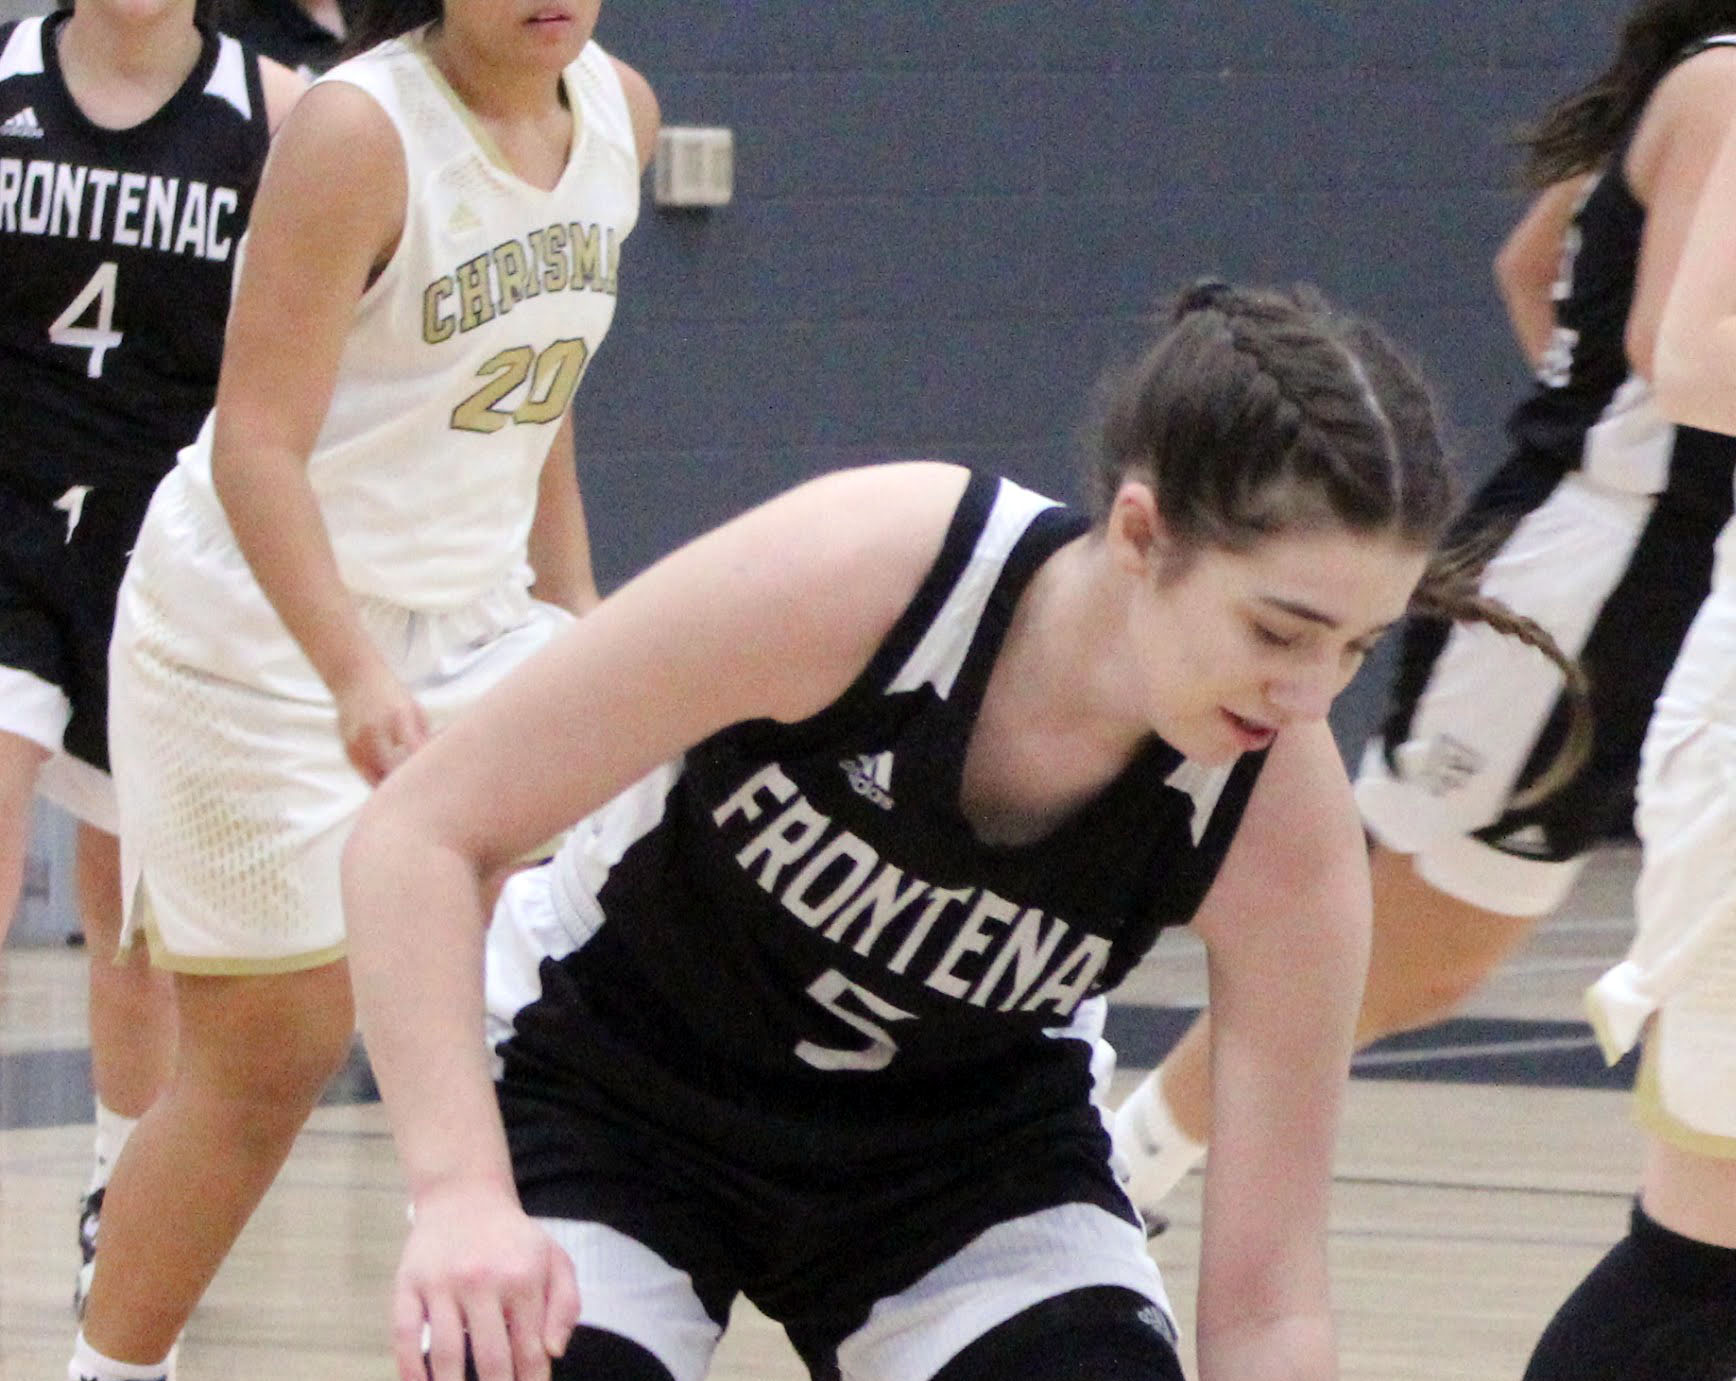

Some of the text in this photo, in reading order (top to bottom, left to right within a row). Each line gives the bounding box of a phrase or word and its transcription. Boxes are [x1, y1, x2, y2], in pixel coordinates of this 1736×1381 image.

[48, 262, 123, 379] 4
[449, 337, 588, 433] 20
[794, 968, 920, 1072] 5
